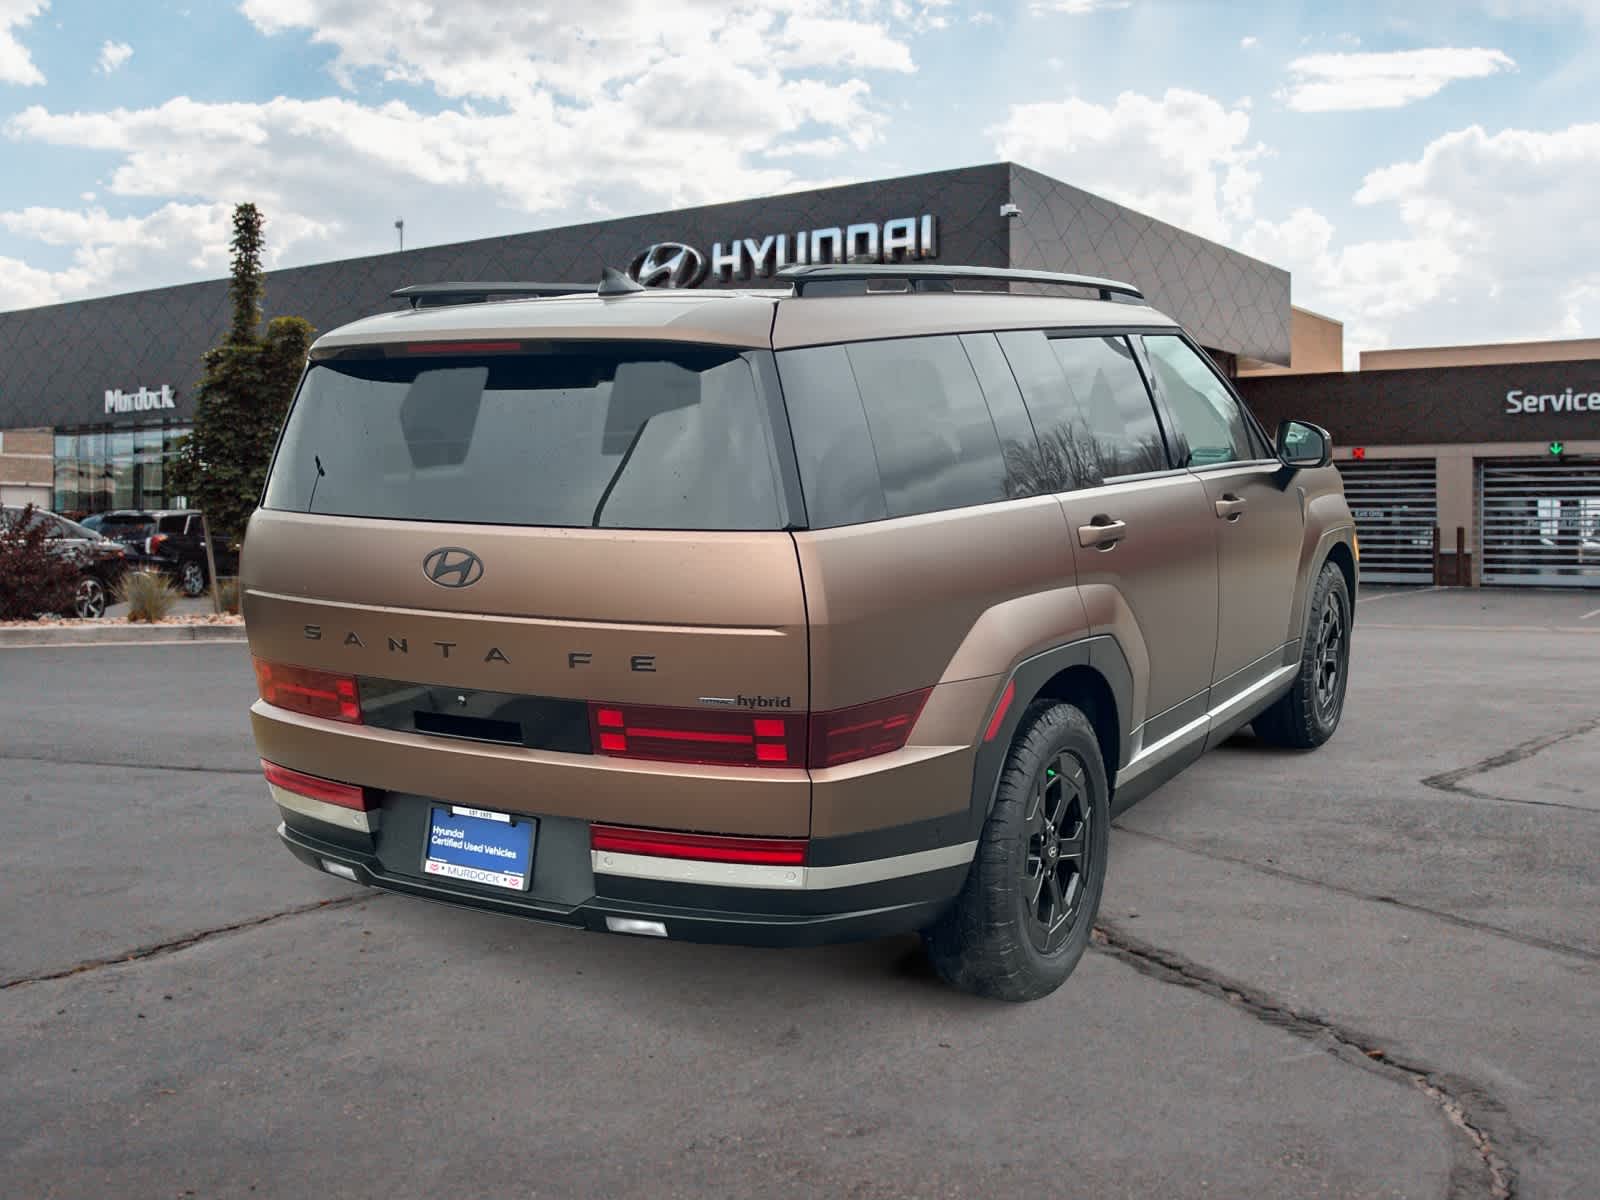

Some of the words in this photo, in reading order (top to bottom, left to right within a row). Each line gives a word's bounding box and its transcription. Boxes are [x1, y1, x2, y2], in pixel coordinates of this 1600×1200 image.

[712, 214, 937, 280] HYUNDAI
[104, 384, 175, 413] Murdock
[1505, 388, 1600, 414] Service
[303, 625, 512, 665] SANTA
[568, 652, 657, 673] FE
[737, 695, 791, 709] hybrid
[432, 825, 464, 840] Hyundai
[431, 835, 463, 849] Certified
[464, 841, 483, 853] Used
[485, 845, 517, 859] Vehicles
[447, 866, 500, 884] MURDOCK
